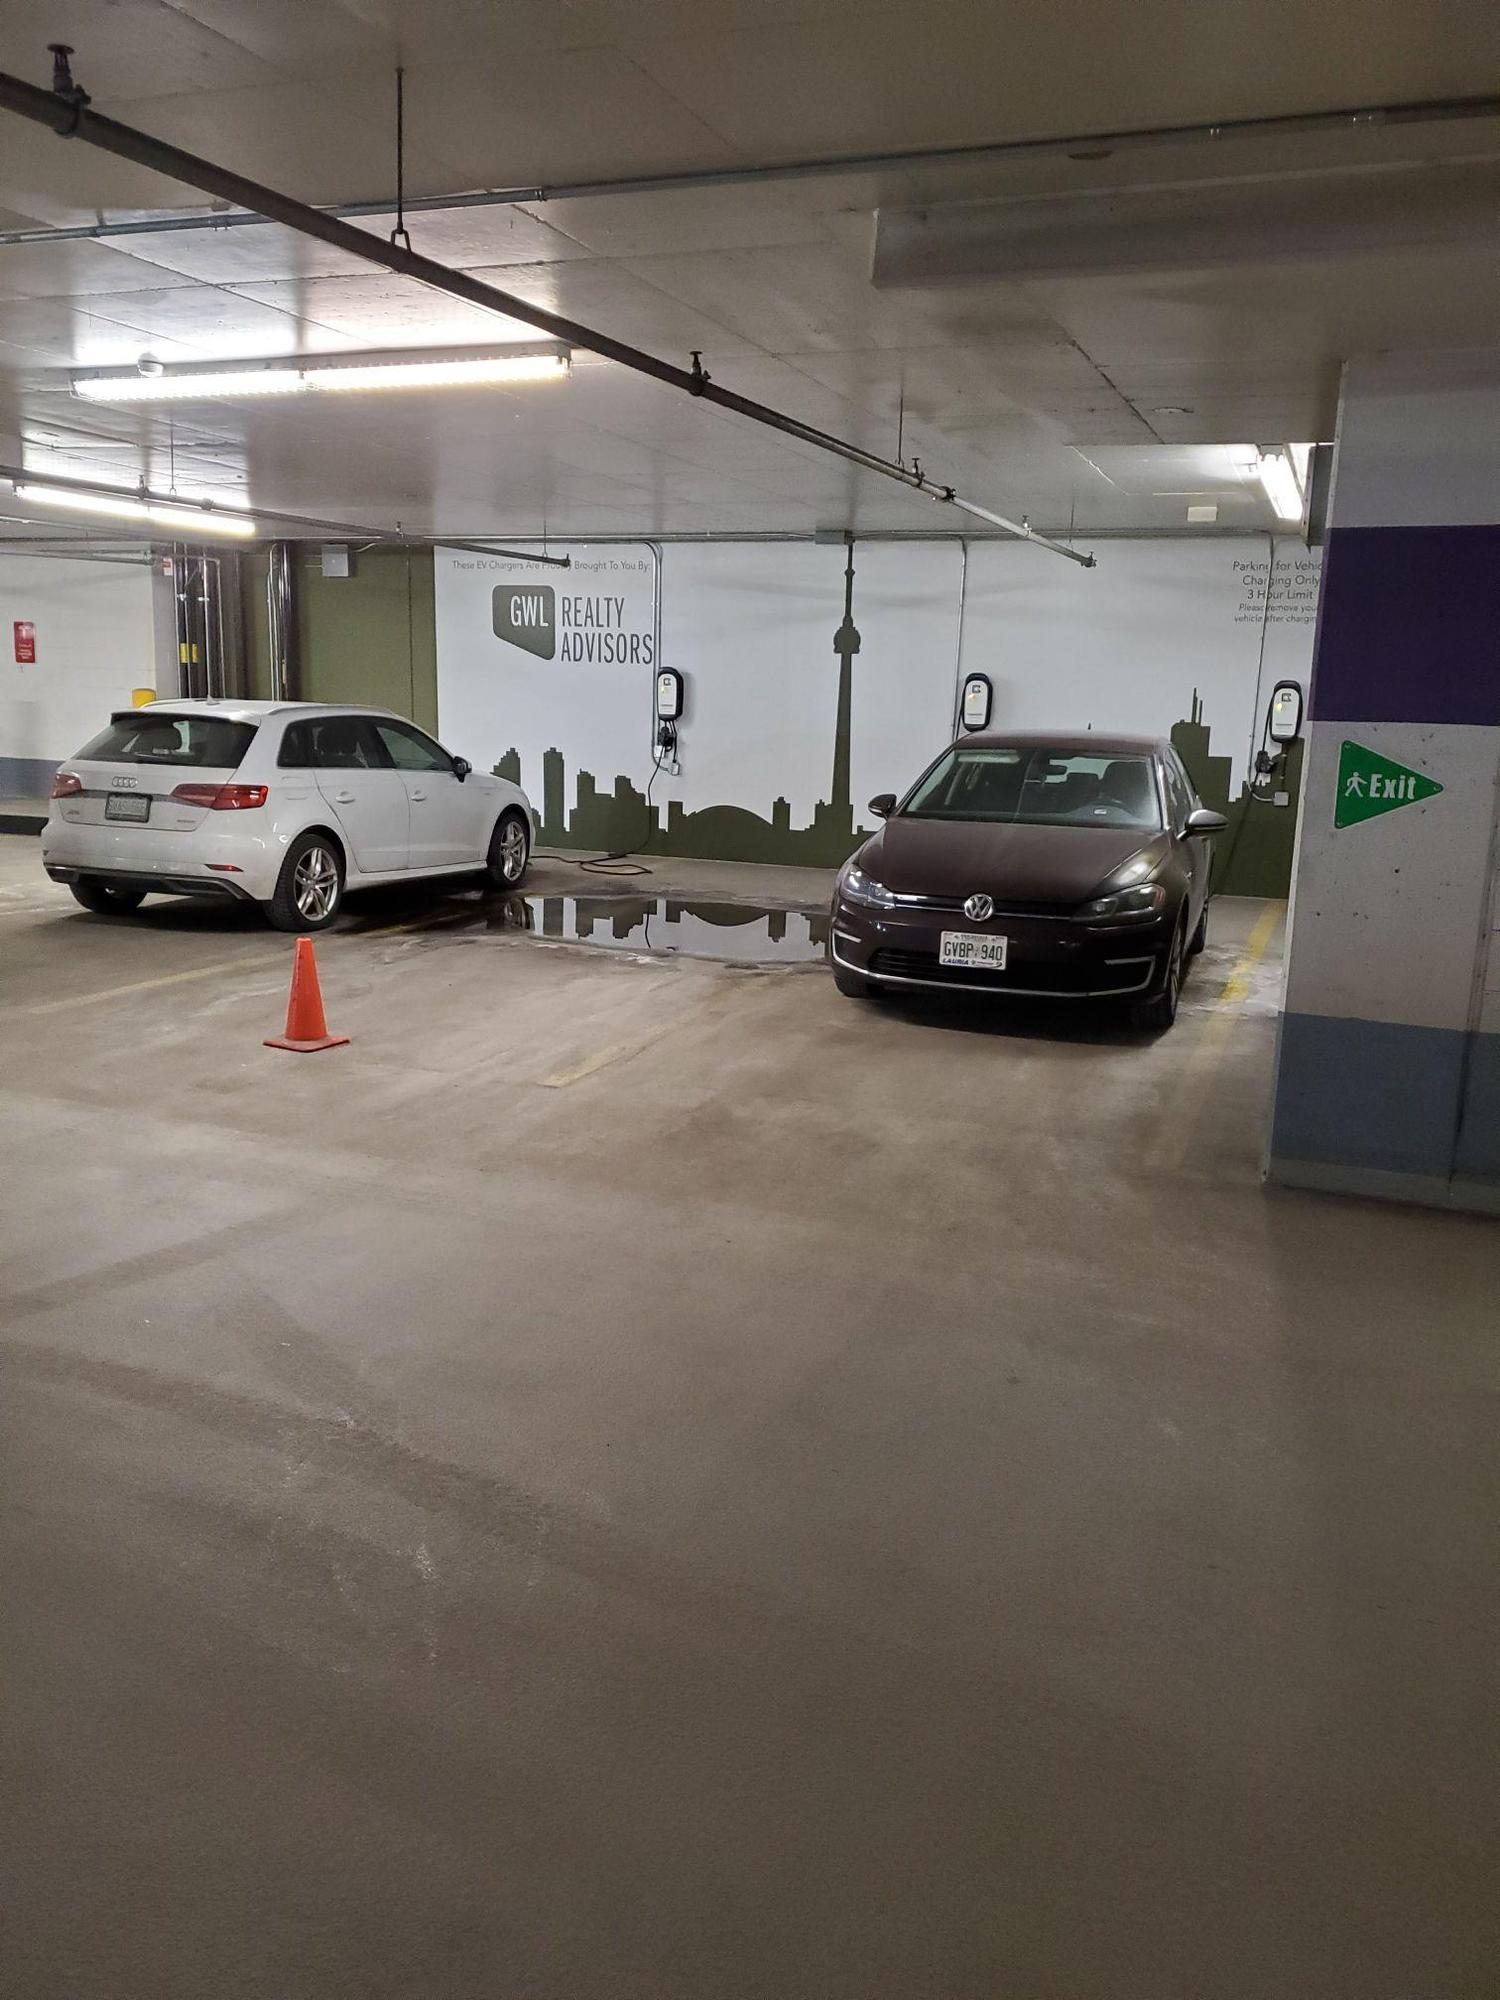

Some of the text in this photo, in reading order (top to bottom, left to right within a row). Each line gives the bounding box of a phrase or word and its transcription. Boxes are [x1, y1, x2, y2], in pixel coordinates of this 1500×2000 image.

[452, 560, 475, 570] These
[477, 560, 487, 569] EV
[489, 560, 524, 572] Chargers
[526, 561, 540, 570] Are
[574, 560, 607, 572] Brought
[610, 560, 619, 570] To
[620, 560, 636, 570] You
[1276, 560, 1291, 570] for
[1242, 574, 1319, 588] Charging Only
[1247, 589, 1313, 600] 3 Hour Limit
[510, 595, 549, 627] GWL
[561, 597, 625, 628] REALTY
[560, 632, 653, 664] ADVISORS
[1369, 773, 1416, 800] Exit
[981, 944, 1003, 961] 940
